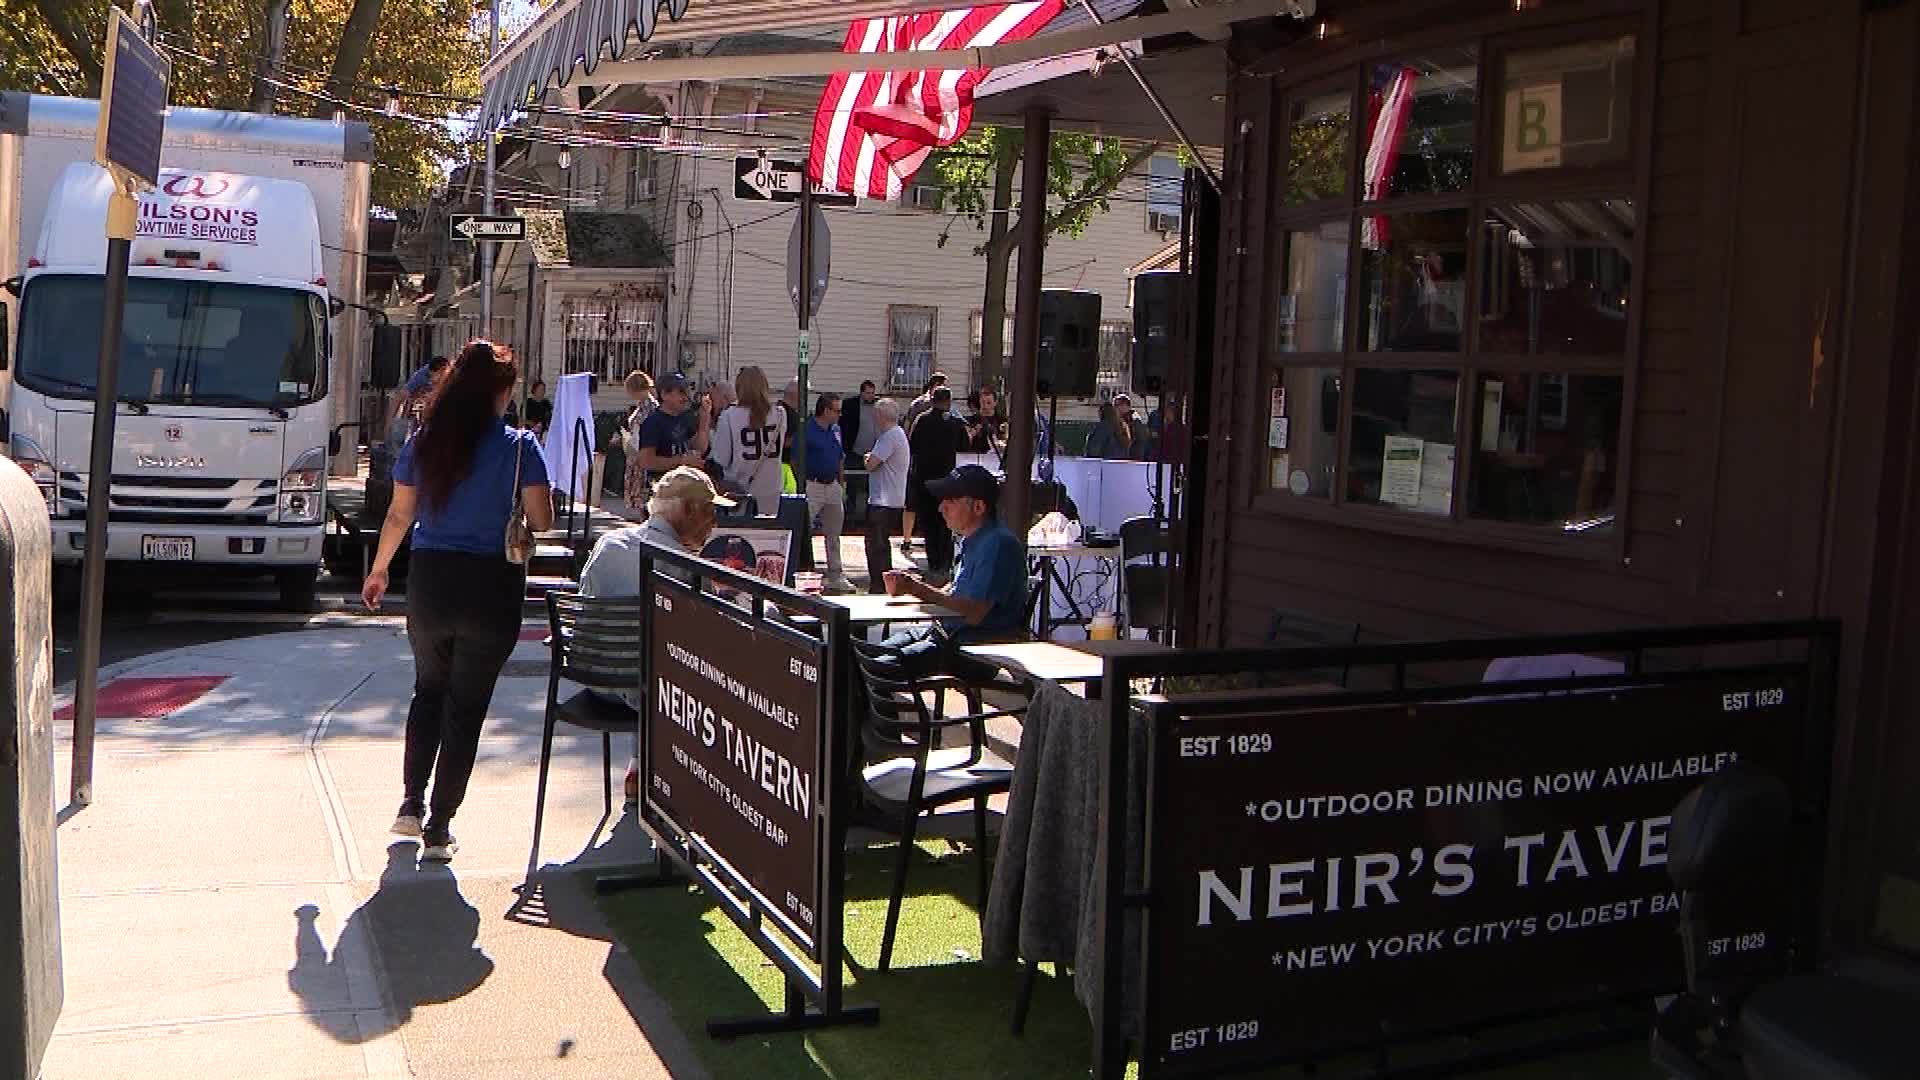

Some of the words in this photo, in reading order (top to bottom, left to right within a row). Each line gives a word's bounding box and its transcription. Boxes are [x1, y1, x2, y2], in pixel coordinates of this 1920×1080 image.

[1518, 100, 1547, 152] B
[755, 171, 789, 189] ONE
[138, 201, 258, 227] ILSON'S
[136, 221, 187, 235] OWTIME
[191, 222, 257, 241] SERVICES
[463, 223, 483, 233] ONE
[493, 223, 513, 233] WAY
[166, 428, 180, 440] 12
[790, 657, 802, 676] EST
[701, 659, 726, 688] DINING
[727, 675, 745, 700] NOW
[1723, 693, 1750, 711] EST
[1755, 688, 1783, 708] 1829
[658, 677, 716, 747] NEIR'S
[721, 716, 810, 819] TAVERN
[1180, 737, 1220, 757] EST
[1227, 734, 1272, 754] 1829
[689, 757, 708, 784] YORK
[708, 774, 730, 803] CITY'S
[732, 793, 765, 831] OLDEST
[1425, 778, 1523, 808] DINING
[1533, 769, 1596, 797] NOW
[1197, 844, 1474, 927] NEIR'S
[1504, 815, 1673, 886] TAVE
[787, 892, 798, 913] EST
[1366, 929, 1443, 960] YORK
[1453, 917, 1537, 946] CITY'S
[1546, 898, 1643, 931] OLDEST
[1651, 890, 1687, 914] BA
[1735, 932, 1766, 952] 1829
[1170, 1028, 1209, 1051] EST
[1215, 1021, 1259, 1044] 1829
